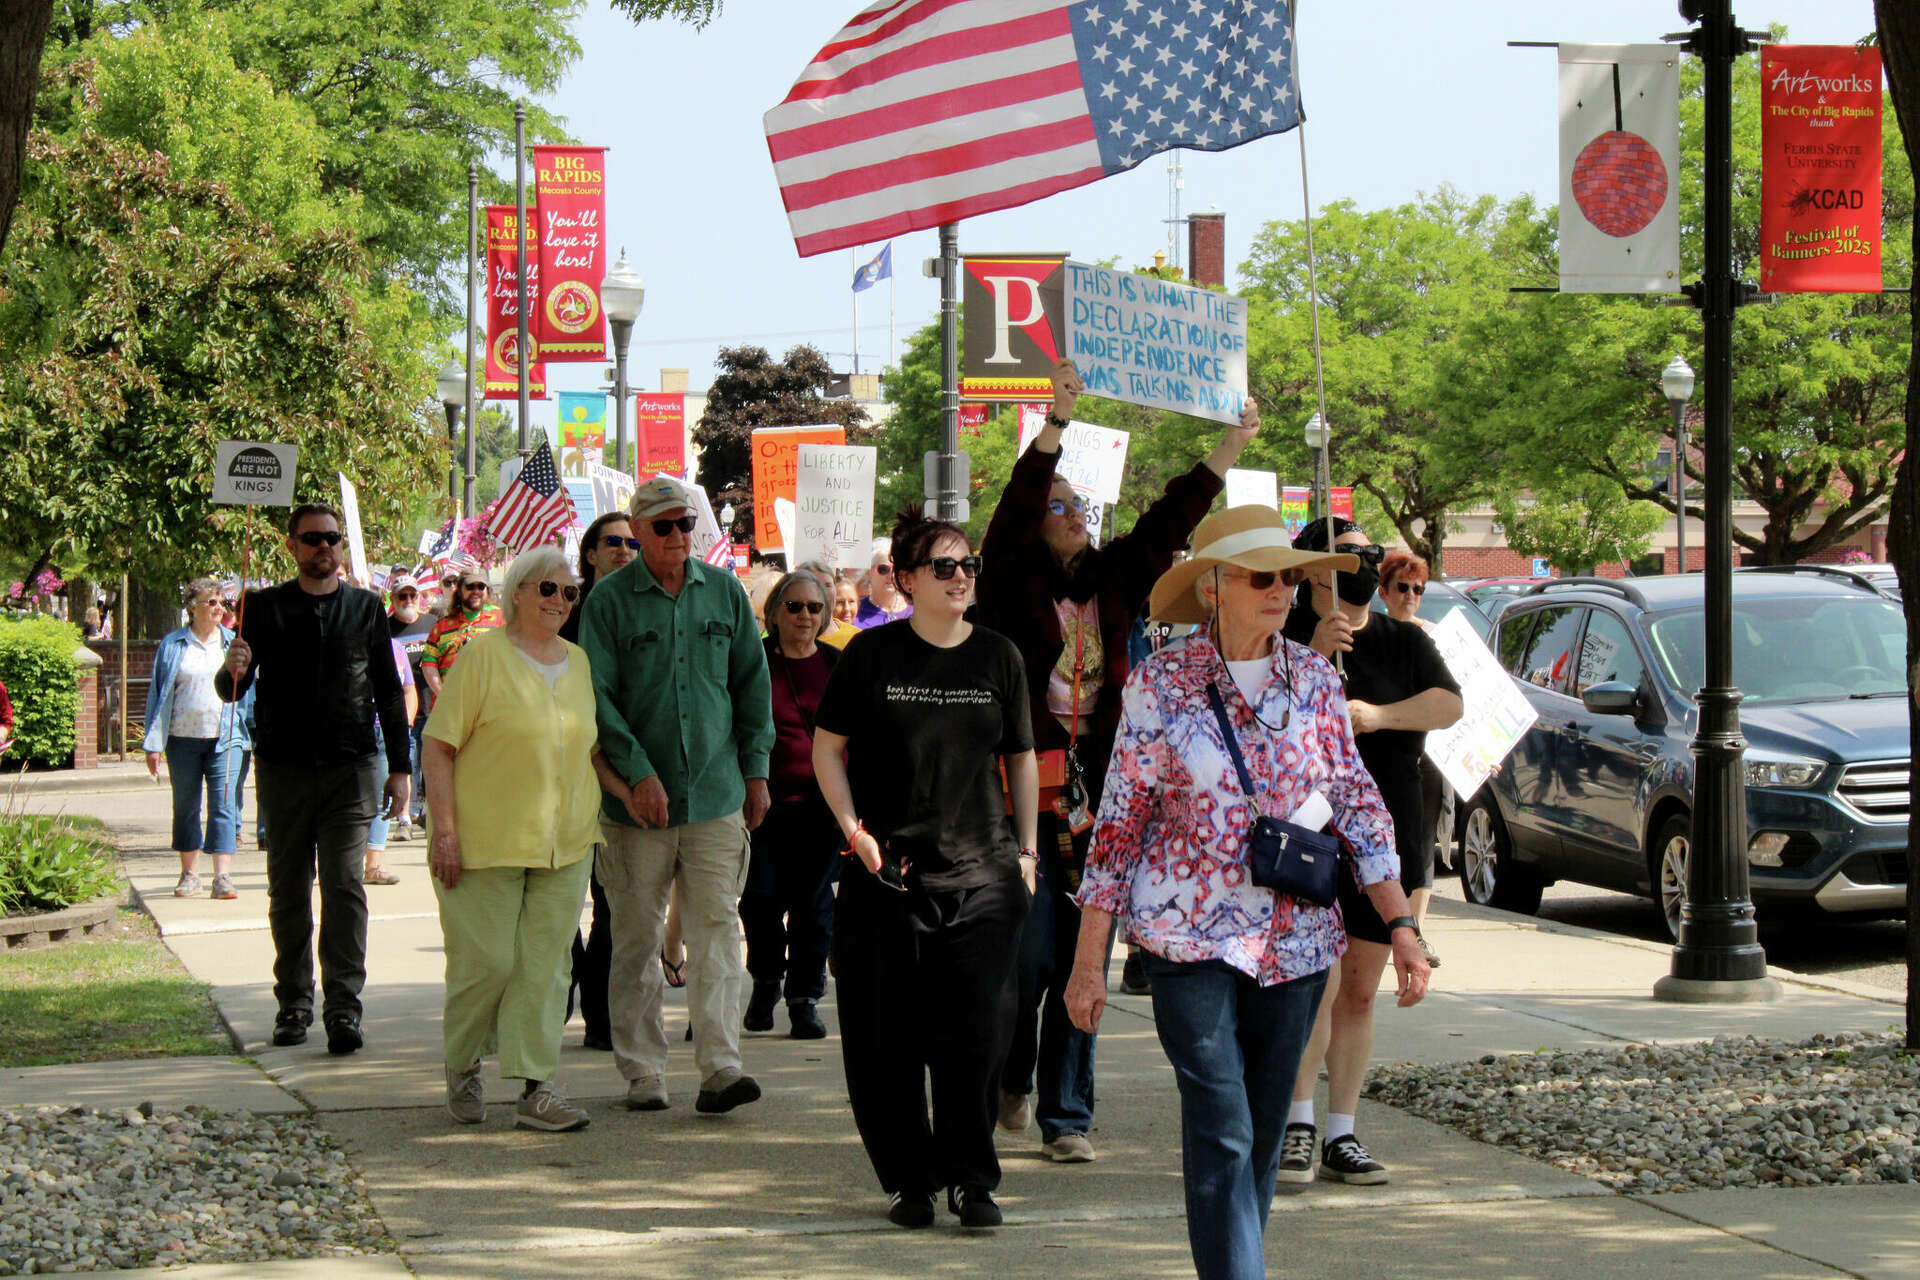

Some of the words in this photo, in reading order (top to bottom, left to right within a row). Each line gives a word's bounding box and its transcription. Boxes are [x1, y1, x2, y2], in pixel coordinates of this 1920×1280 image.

[1771, 67, 1873, 96] Artworks
[1818, 96, 1826, 104] &
[1770, 105, 1789, 117] The
[1791, 105, 1810, 119] City
[1812, 105, 1822, 117] of
[1823, 106, 1840, 119] Big
[1842, 106, 1874, 120] Rapids
[1809, 118, 1835, 128] thank
[554, 156, 585, 170] BIG
[1787, 157, 1858, 169] UNIVERSITY
[539, 169, 602, 183] RAPIDS
[539, 186, 572, 195] Mecosta
[574, 186, 601, 198] County
[1808, 189, 1863, 210] KCAD
[546, 209, 599, 229] You'll
[543, 229, 579, 248] love
[581, 231, 600, 248] it
[1785, 226, 1840, 246] Festival
[1844, 224, 1860, 238] of
[554, 248, 594, 269] here!
[1771, 243, 1831, 260] Banners
[1835, 239, 1872, 256] 2025
[1068, 265, 1112, 297] THIS
[1118, 276, 1137, 303] IS
[1142, 282, 1199, 313] WHAT
[1202, 293, 1239, 326] THE
[983, 276, 1045, 364] P
[1072, 297, 1219, 355] DECLARATION
[1219, 333, 1244, 353] OF
[1073, 330, 1226, 384] INDEPENDENCE
[1073, 360, 1122, 396] WAS
[1126, 372, 1195, 404] TALKING
[237, 455, 277, 464] PRESIDENTS
[803, 453, 866, 473] LIBERTY
[233, 464, 254, 474] ARE
[256, 465, 279, 475] NOT
[592, 464, 614, 480] JOIN
[763, 462, 777, 477] is
[235, 480, 273, 492] KINGS
[825, 477, 852, 489] AND
[801, 497, 864, 517] JUSTICE
[803, 525, 825, 539] FOR
[833, 520, 860, 541] ALL
